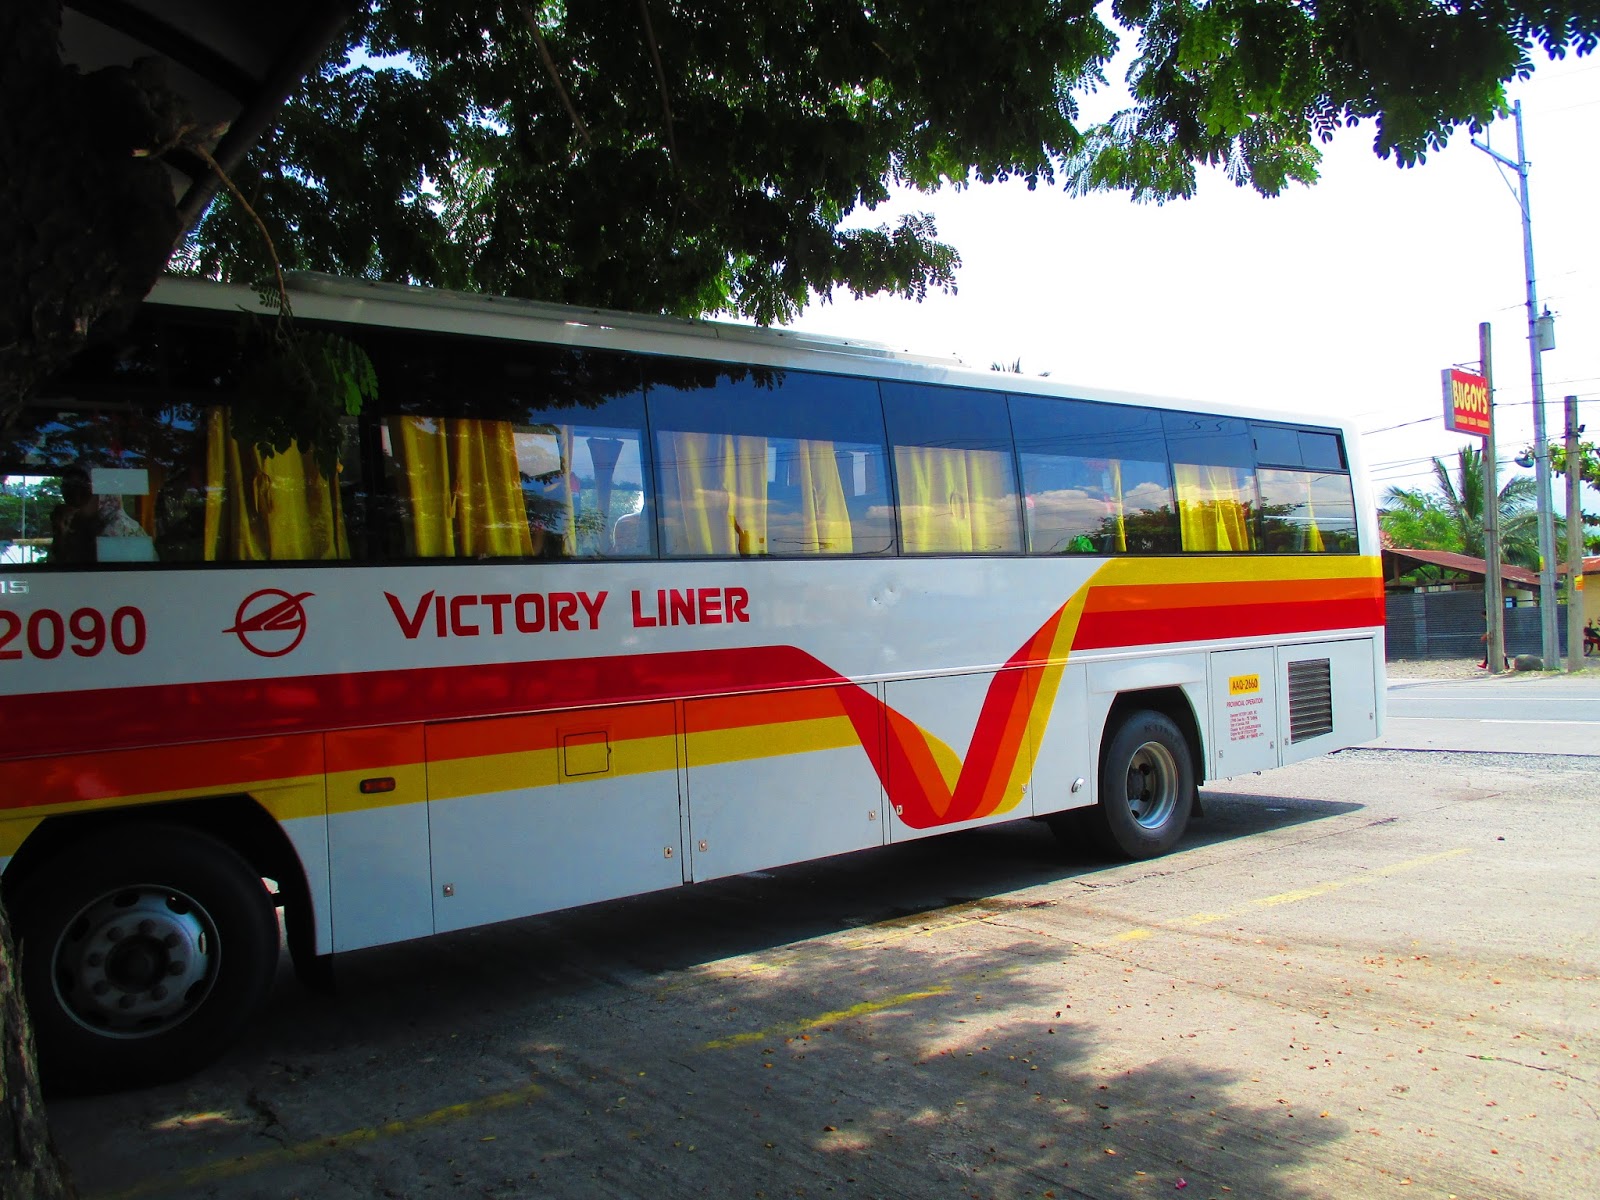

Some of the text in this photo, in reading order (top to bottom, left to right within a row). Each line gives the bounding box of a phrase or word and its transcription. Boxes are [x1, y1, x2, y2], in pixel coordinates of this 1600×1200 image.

[1452, 379, 1488, 415] BUGOY'S
[0, 605, 147, 660] 2090
[383, 587, 750, 640] VICTORY LINER
[1245, 697, 1263, 706] OPERATION
